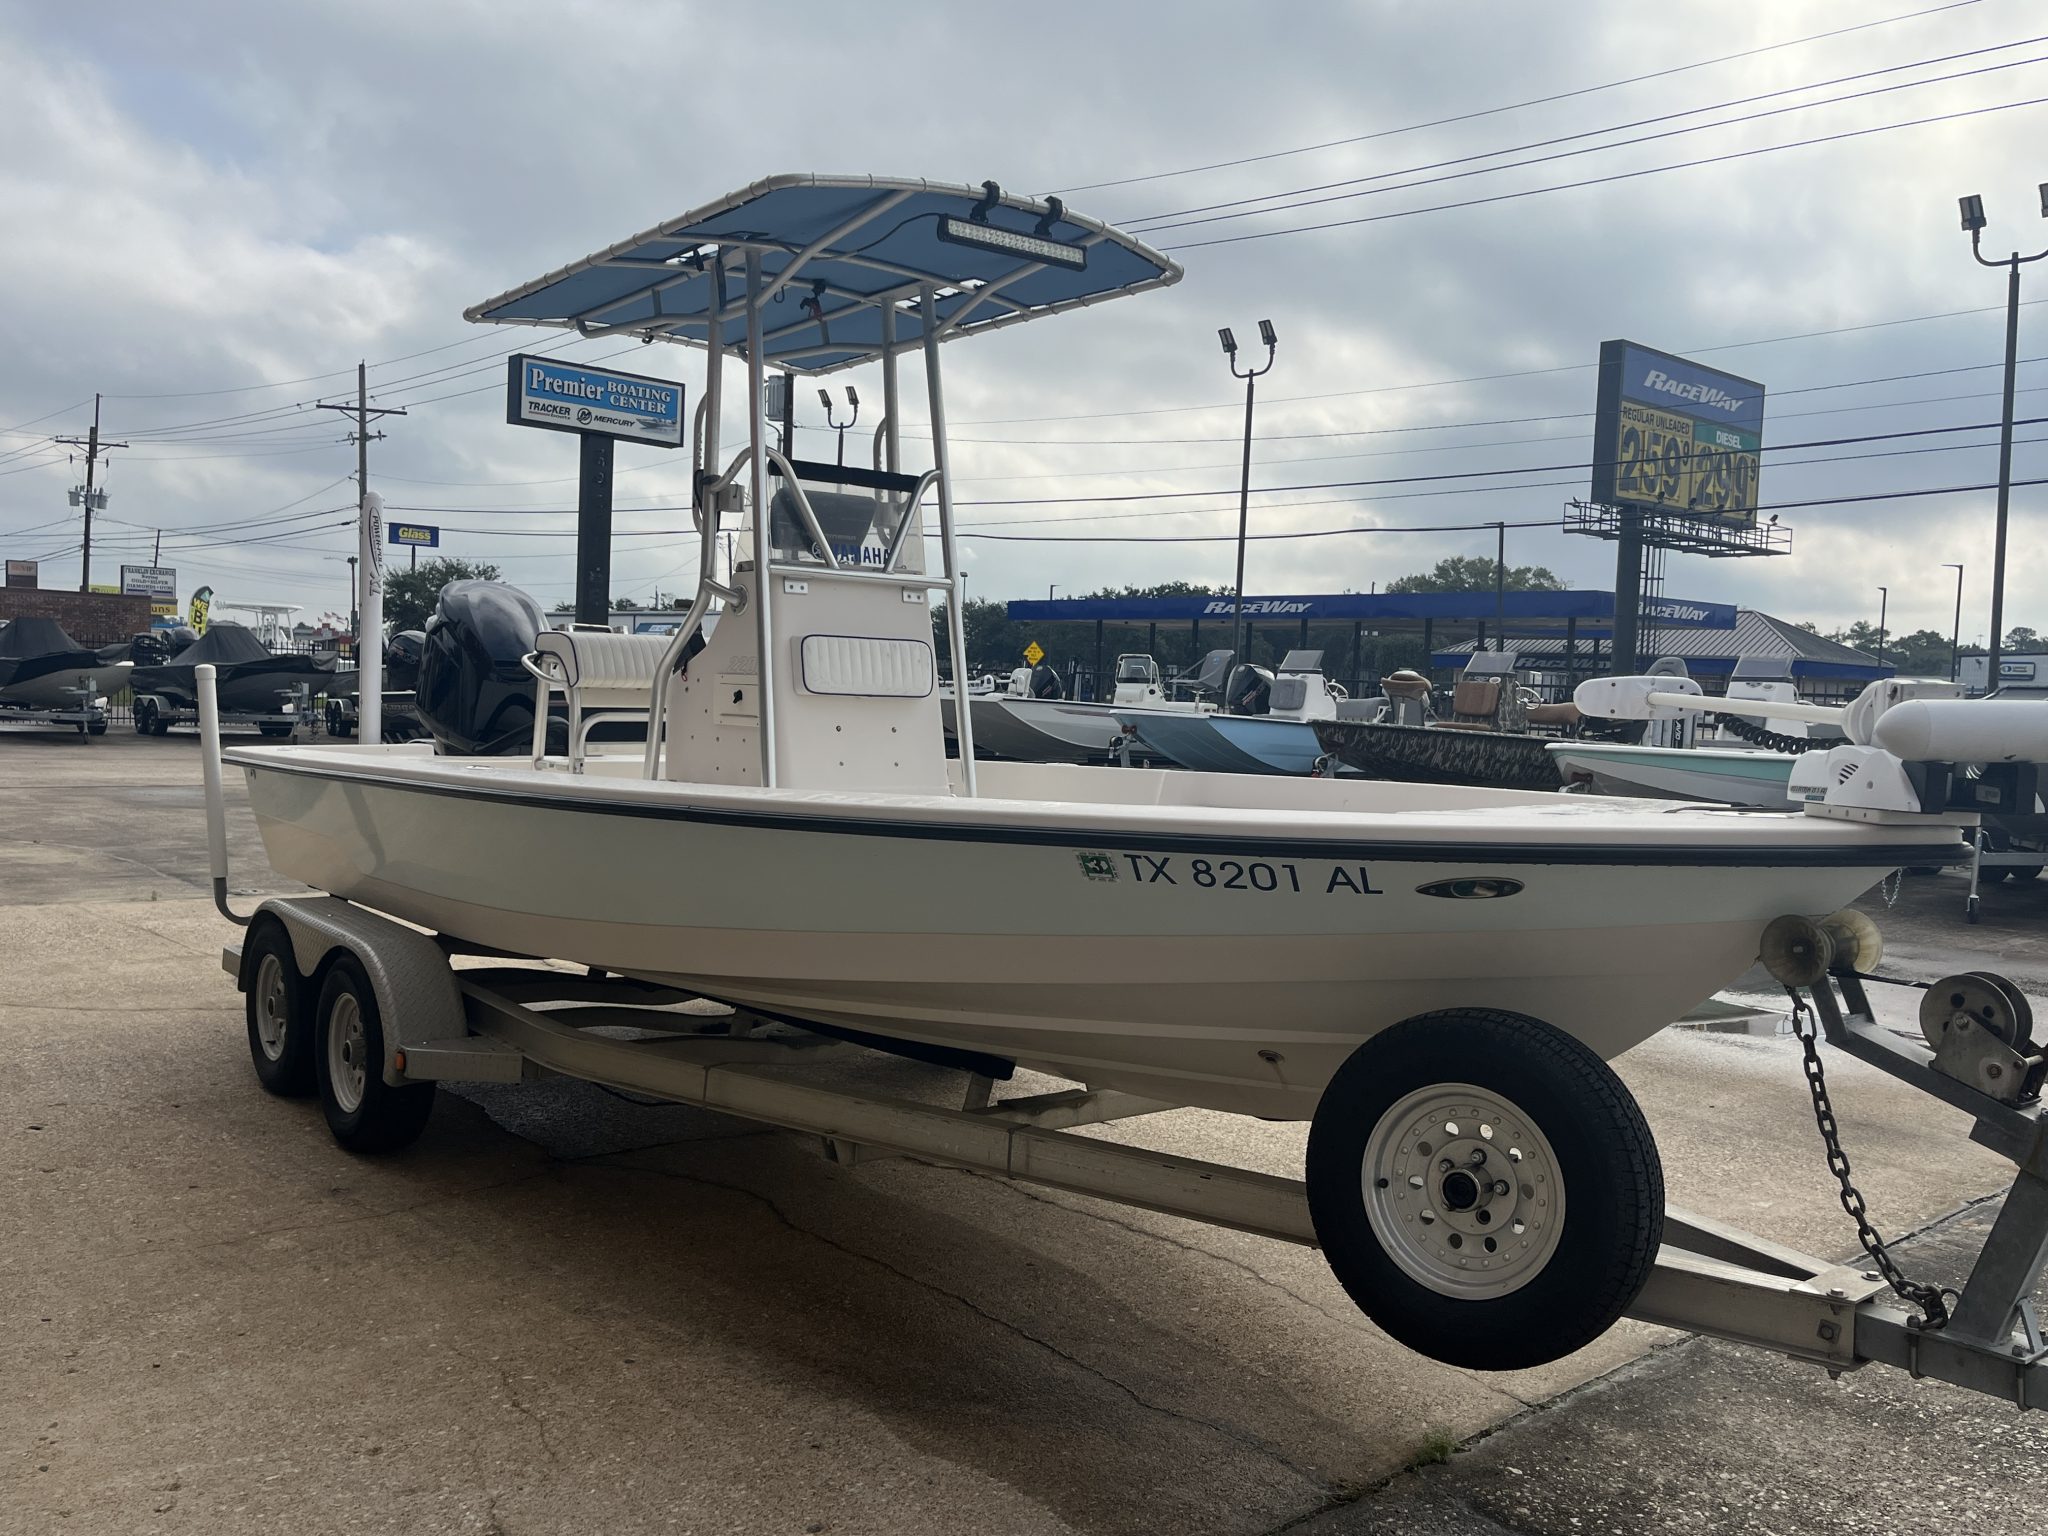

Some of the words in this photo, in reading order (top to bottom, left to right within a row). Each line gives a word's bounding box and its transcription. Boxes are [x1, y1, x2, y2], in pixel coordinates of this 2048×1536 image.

[530, 367, 604, 402] Premier
[607, 380, 671, 402] BOATING
[528, 401, 571, 417] TRACKER
[593, 414, 636, 428] MERCURY
[610, 394, 666, 415] CENTER
[1622, 405, 1655, 427] REGULAR
[1655, 412, 1690, 435] UNLEADED
[1715, 430, 1742, 449] DIESEL
[398, 527, 431, 541] Glass
[126, 567, 149, 575] FRANKLIN
[149, 568, 175, 577] EXCHANGE
[151, 605, 171, 613] uns
[193, 597, 209, 611] WE
[1123, 854, 1178, 885] TX
[1191, 858, 1301, 893] 8201
[1326, 865, 1384, 895] AL
